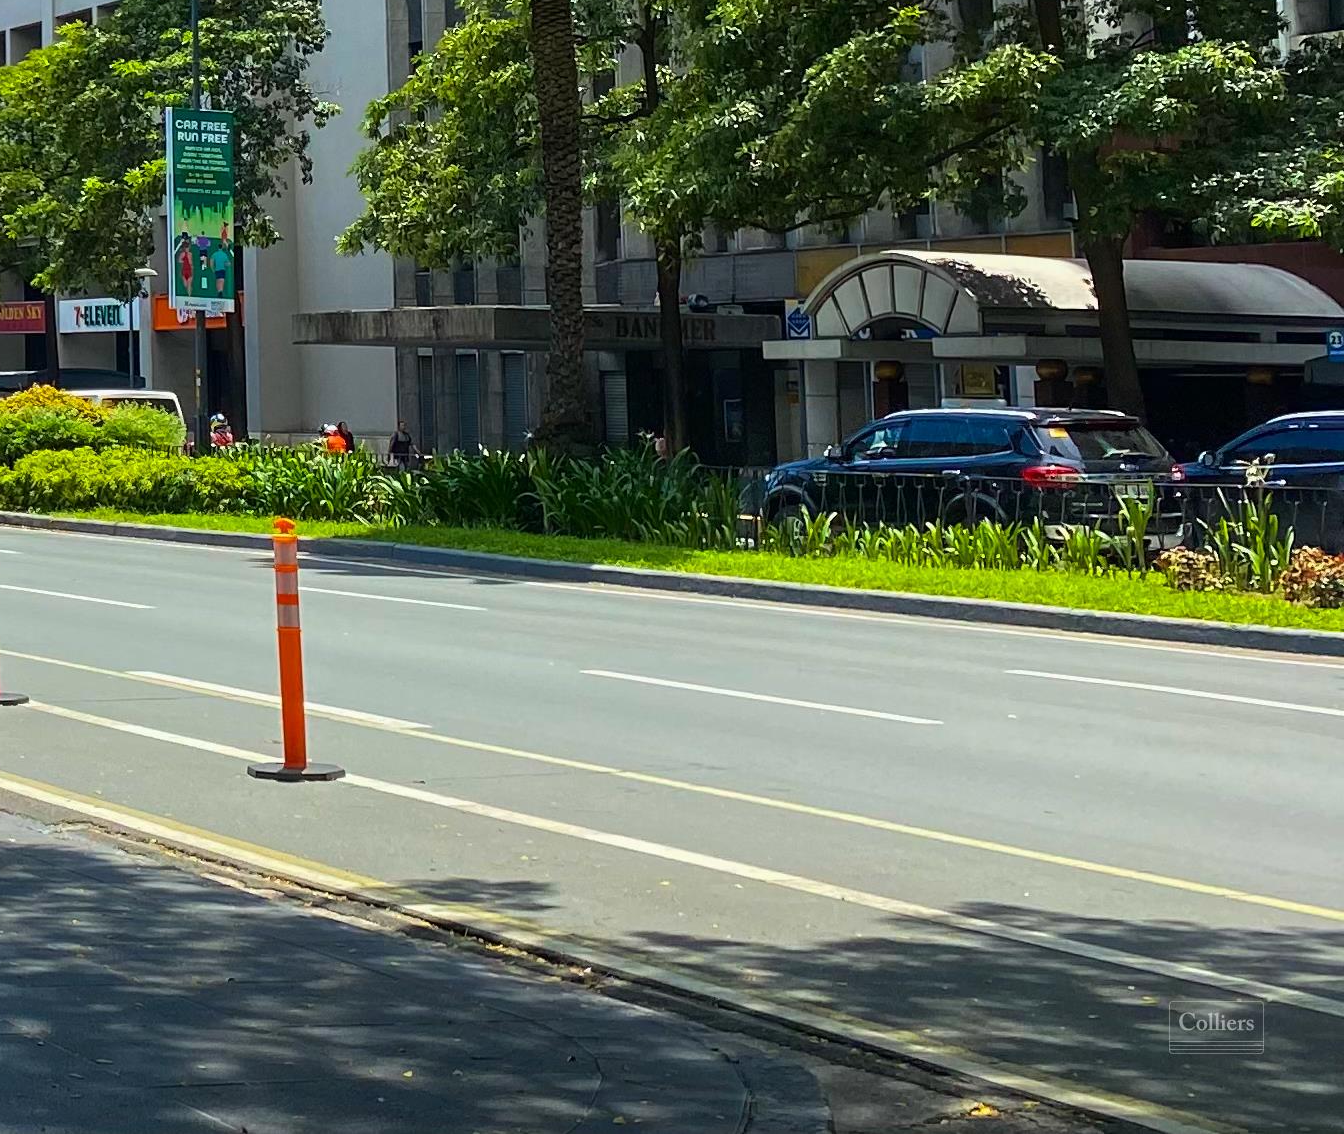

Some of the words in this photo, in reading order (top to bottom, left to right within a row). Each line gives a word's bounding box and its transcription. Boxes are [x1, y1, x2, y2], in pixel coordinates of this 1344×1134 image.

[175, 119, 199, 131] CAR
[200, 120, 231, 134] FREE,
[177, 131, 199, 142] RUN
[201, 132, 229, 144] FREE
[25, 304, 42, 320] SKY
